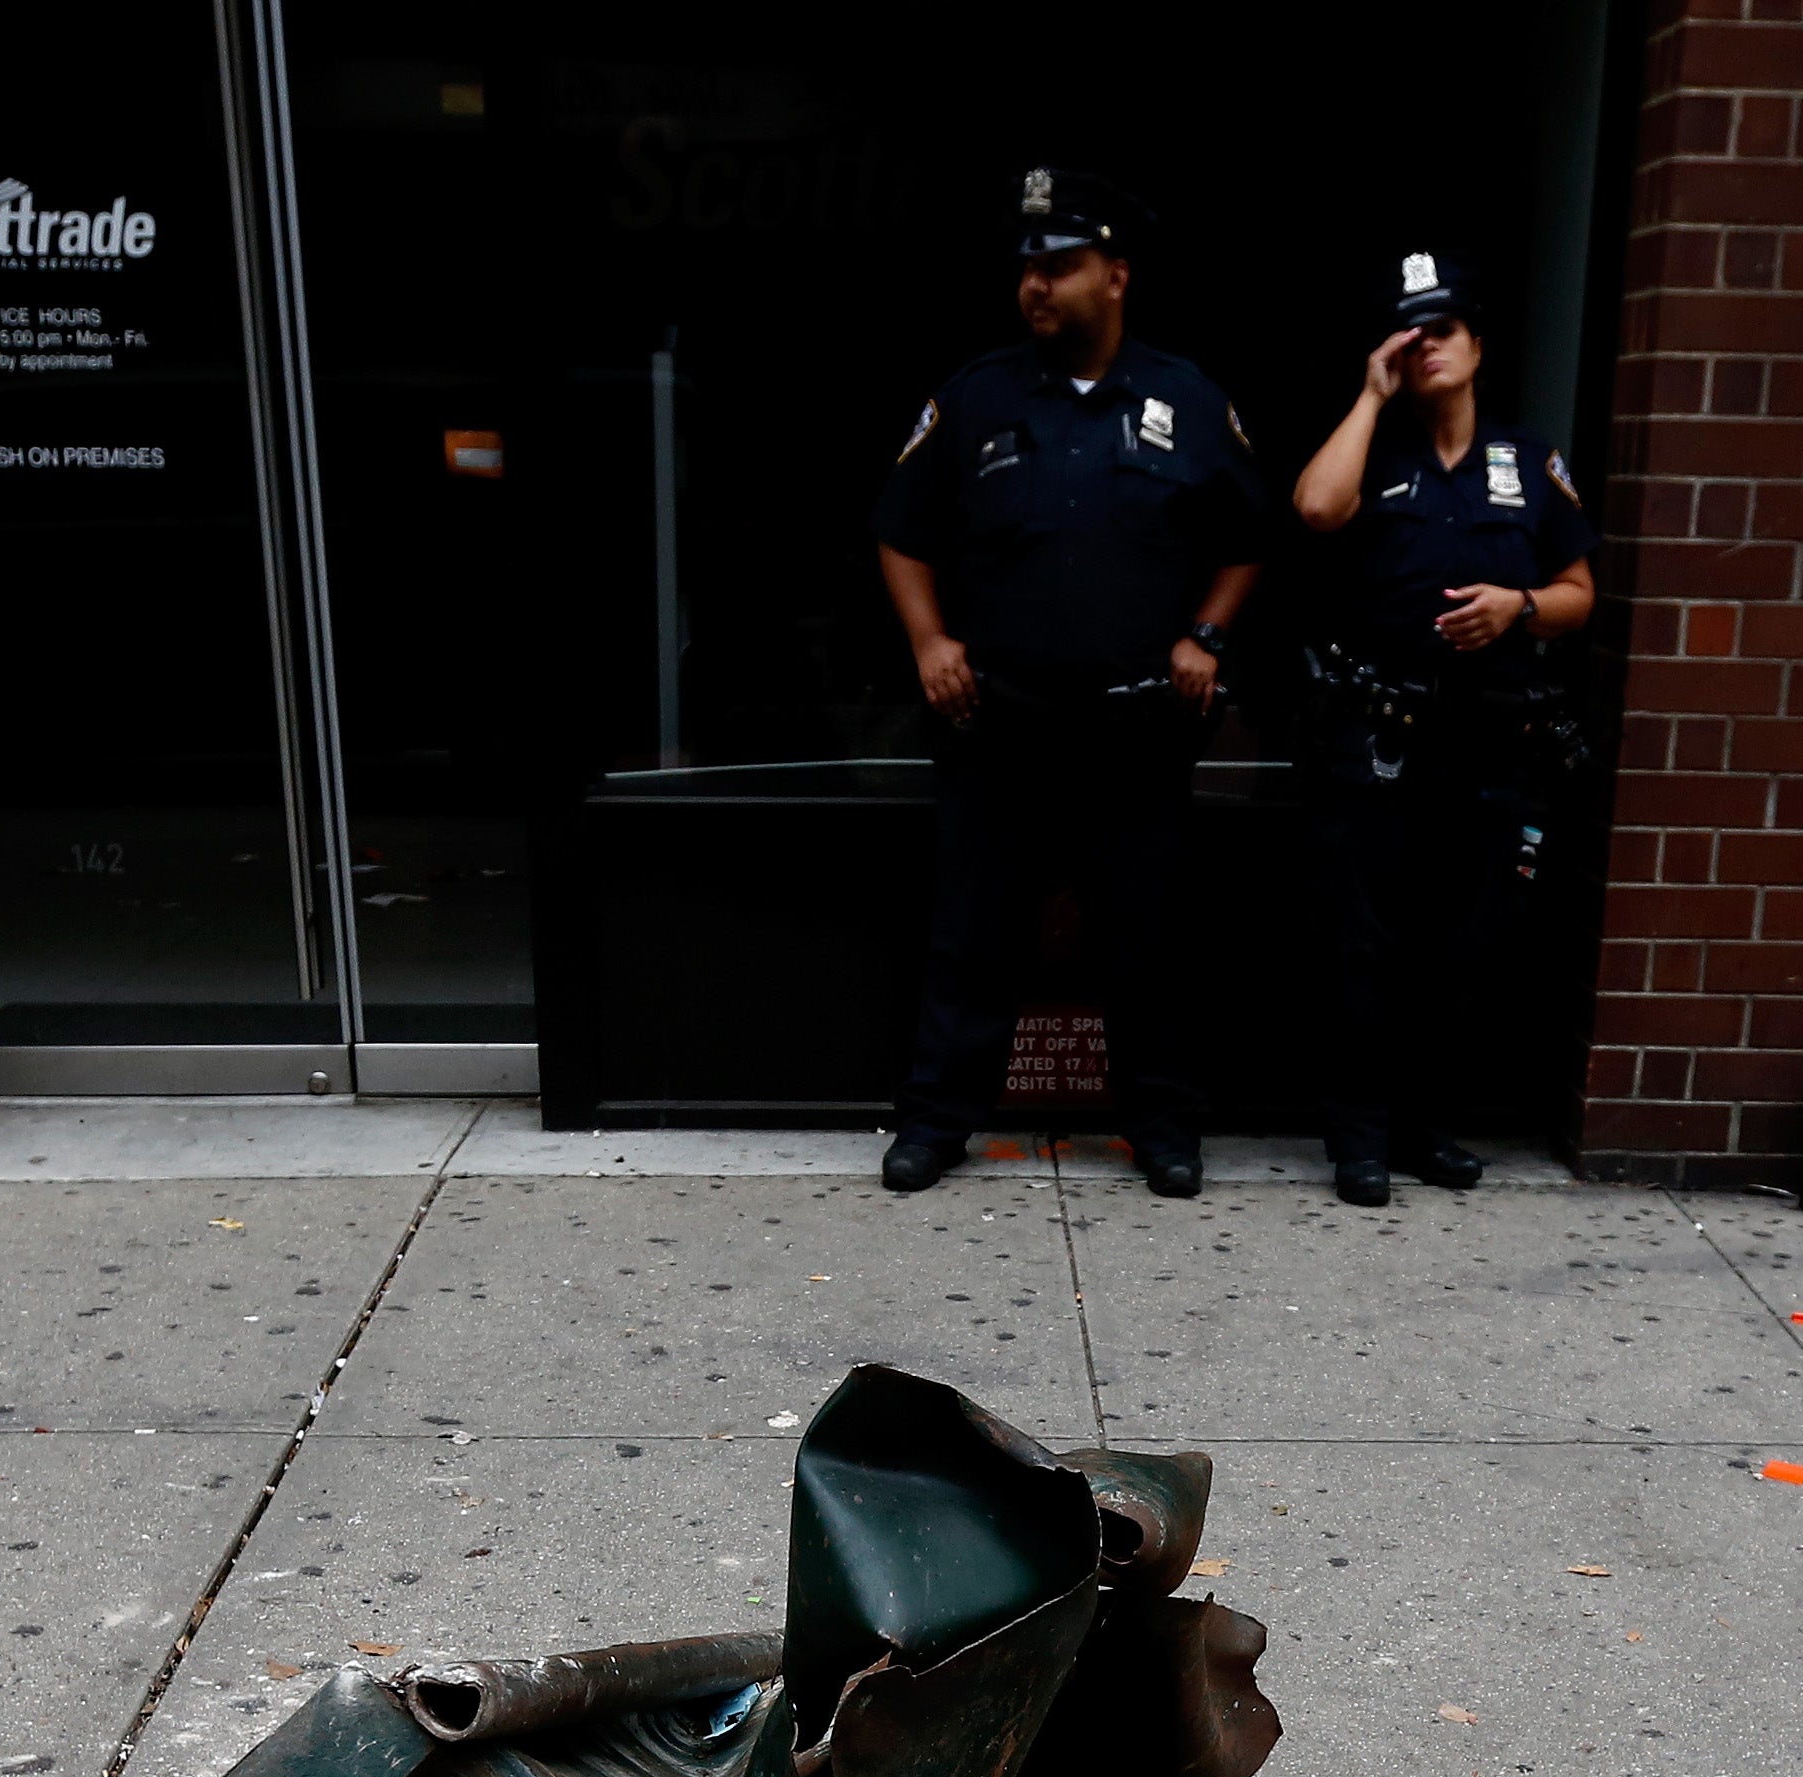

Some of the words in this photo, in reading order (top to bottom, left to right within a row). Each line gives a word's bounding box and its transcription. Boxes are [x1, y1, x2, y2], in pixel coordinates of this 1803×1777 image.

[37, 257, 124, 272] SERVICES
[38, 307, 103, 327] HOURS
[37, 332, 63, 350] pm
[19, 352, 114, 372] appointment
[28, 446, 59, 468] ON
[63, 446, 166, 468] PREMISES
[71, 843, 125, 874] 142
[1045, 1037, 1077, 1051] OFF
[1065, 1057, 1081, 1071] 17
[1066, 1076, 1104, 1091] THIS
